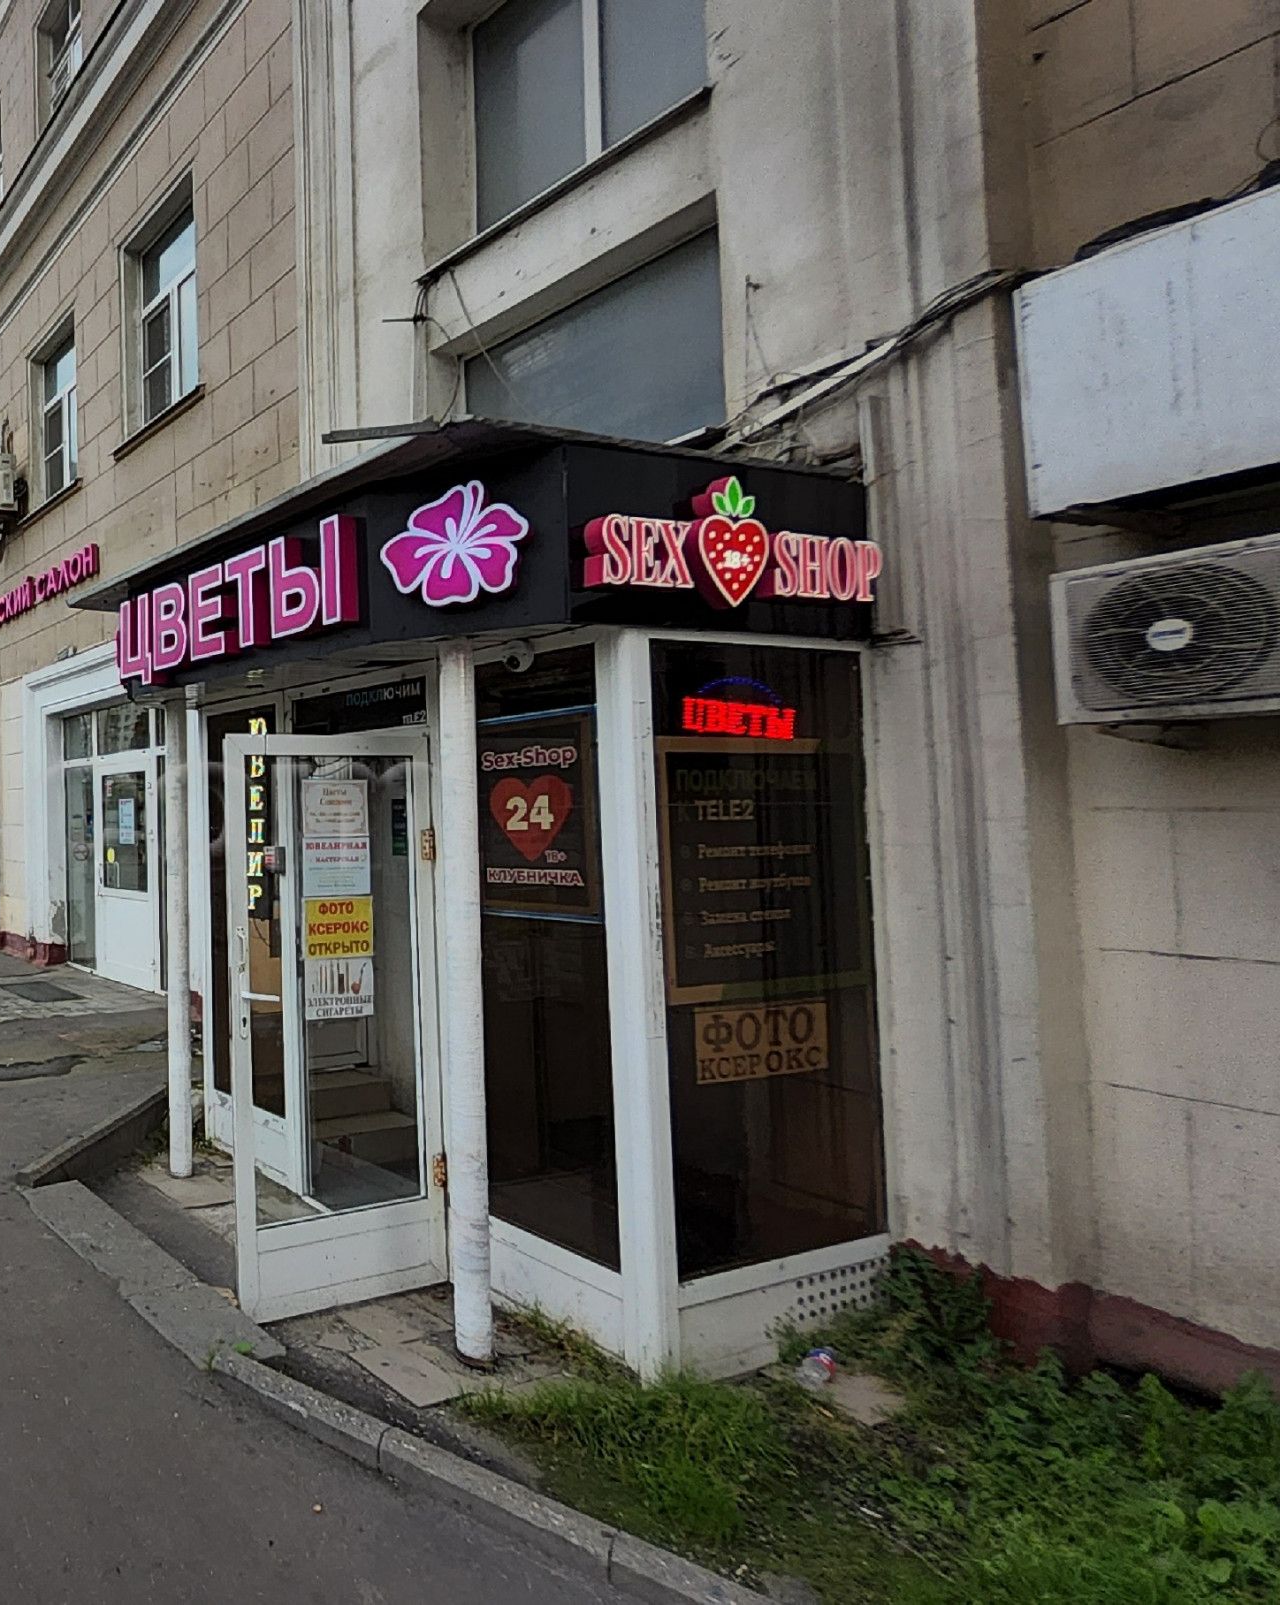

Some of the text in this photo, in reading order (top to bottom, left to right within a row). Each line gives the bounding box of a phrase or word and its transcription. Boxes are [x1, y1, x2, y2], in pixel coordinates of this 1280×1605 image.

[602, 513, 884, 602] SEX SHOP
[723, 550, 749, 568] 18+
[36, 544, 99, 604] САЛОН
[119, 514, 342, 685] ЦВЕТЫ
[346, 681, 421, 707] ПОДКЛЮЧИМ
[682, 696, 796, 742] ЦВЕТЫ
[481, 745, 578, 771] Sex-Shop
[505, 794, 555, 831] 24
[695, 799, 755, 821] TELE2
[545, 850, 568, 863] 18+
[487, 867, 585, 887] КЛУБНИЧКА
[318, 901, 355, 915] ФОТО
[308, 920, 370, 936] КСЕРОКС
[308, 940, 370, 956] ОТКРЫТО
[316, 1006, 364, 1018] СИГАРЕТЫ
[702, 1005, 816, 1053] ФОТО
[699, 1045, 823, 1081] КСЕРОКС
